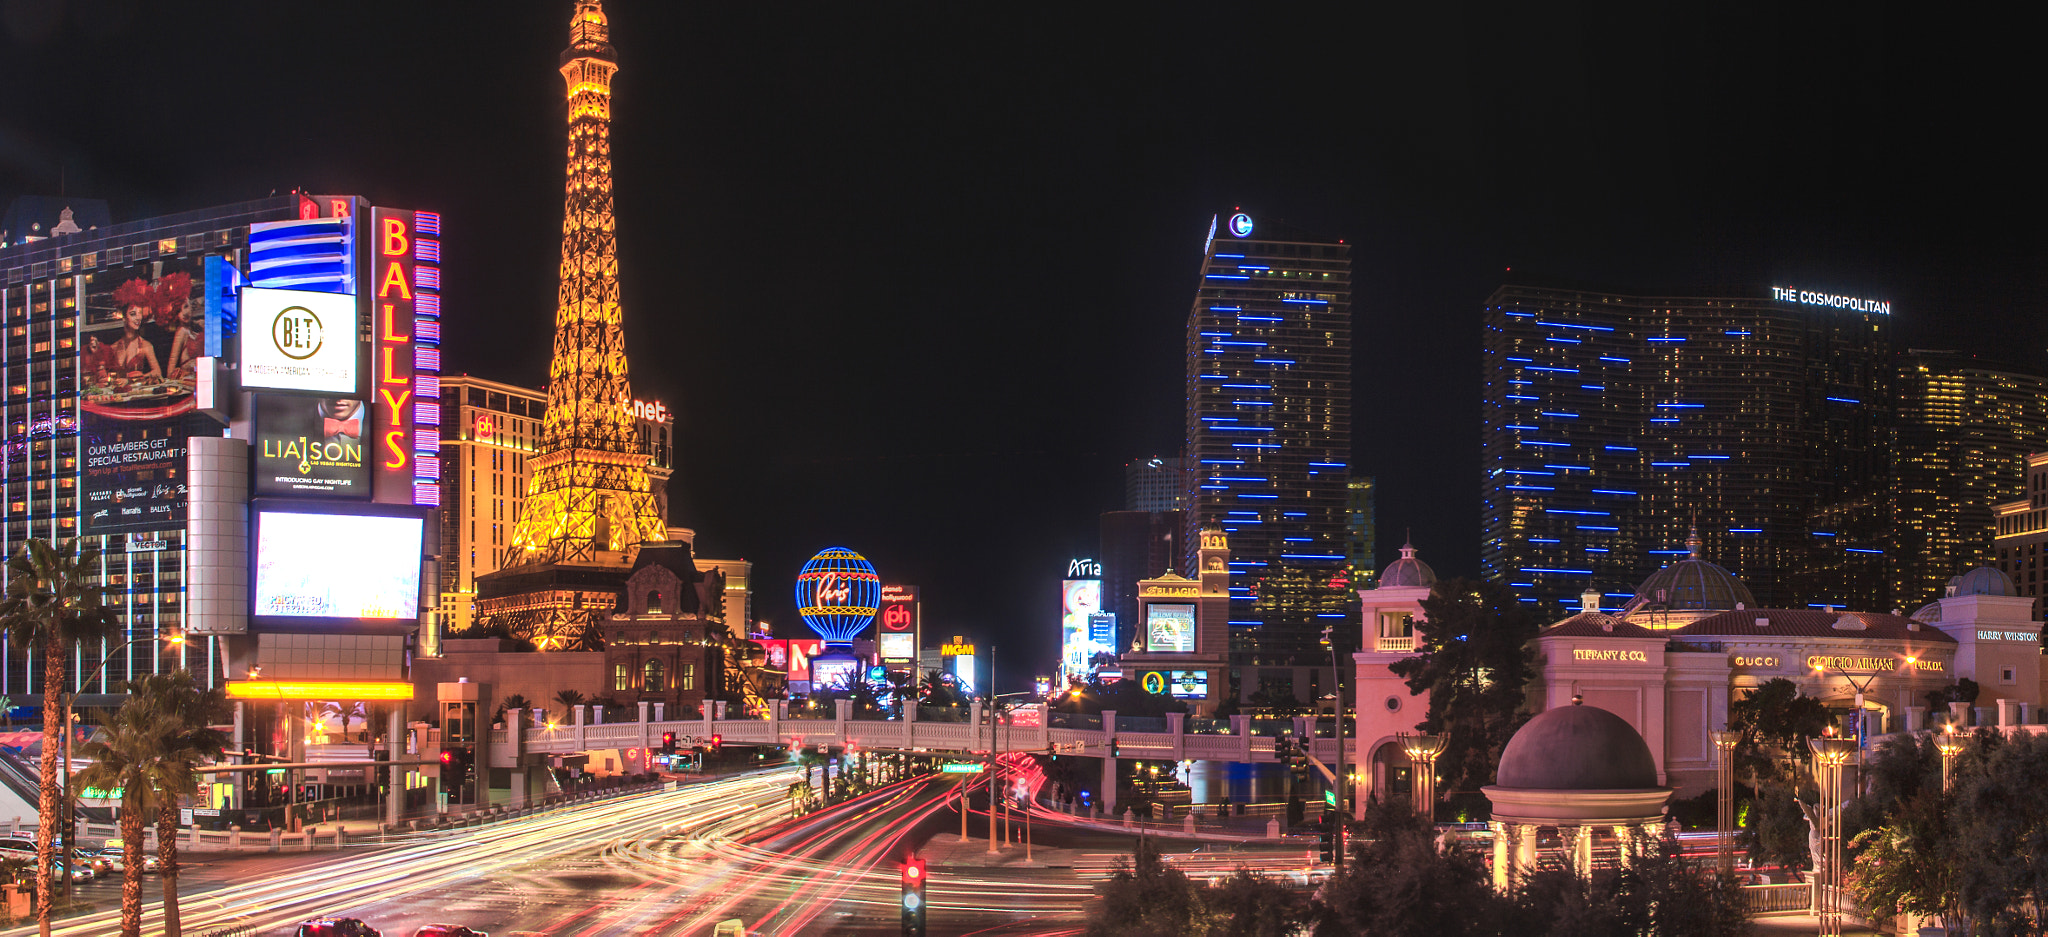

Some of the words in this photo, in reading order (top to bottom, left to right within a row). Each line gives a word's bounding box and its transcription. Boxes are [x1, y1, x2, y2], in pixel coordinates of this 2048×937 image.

[1772, 286, 1797, 302] THE
[1800, 291, 1889, 314] COSMOPOLITAN
[283, 317, 313, 349] BLT
[379, 217, 413, 470] BALLYS
[88, 446, 107, 456] OUR
[108, 441, 149, 453] MEMBERS
[150, 438, 169, 449] GET
[88, 455, 121, 467] SPECIAL
[123, 448, 180, 462] RESTAURANT
[88, 468, 102, 476] Sign
[102, 467, 112, 475] Up
[120, 461, 173, 473] TotalRewards.com
[134, 541, 165, 549] VECTOR
[1067, 558, 1102, 577] Aria
[816, 572, 850, 610] Paris
[882, 585, 903, 594] planet
[1146, 586, 1199, 597] BELLAGIO
[882, 594, 913, 602] hollywood
[1977, 630, 2003, 639] HARRY
[2004, 631, 2038, 642] WINSTON
[941, 645, 975, 655] MGM
[1573, 649, 1618, 661] TIFFANY
[1619, 650, 1628, 661] &
[1735, 656, 1779, 667] GUCCI
[1856, 657, 1895, 671] ARMANI
[1914, 660, 1944, 672] PRADA
